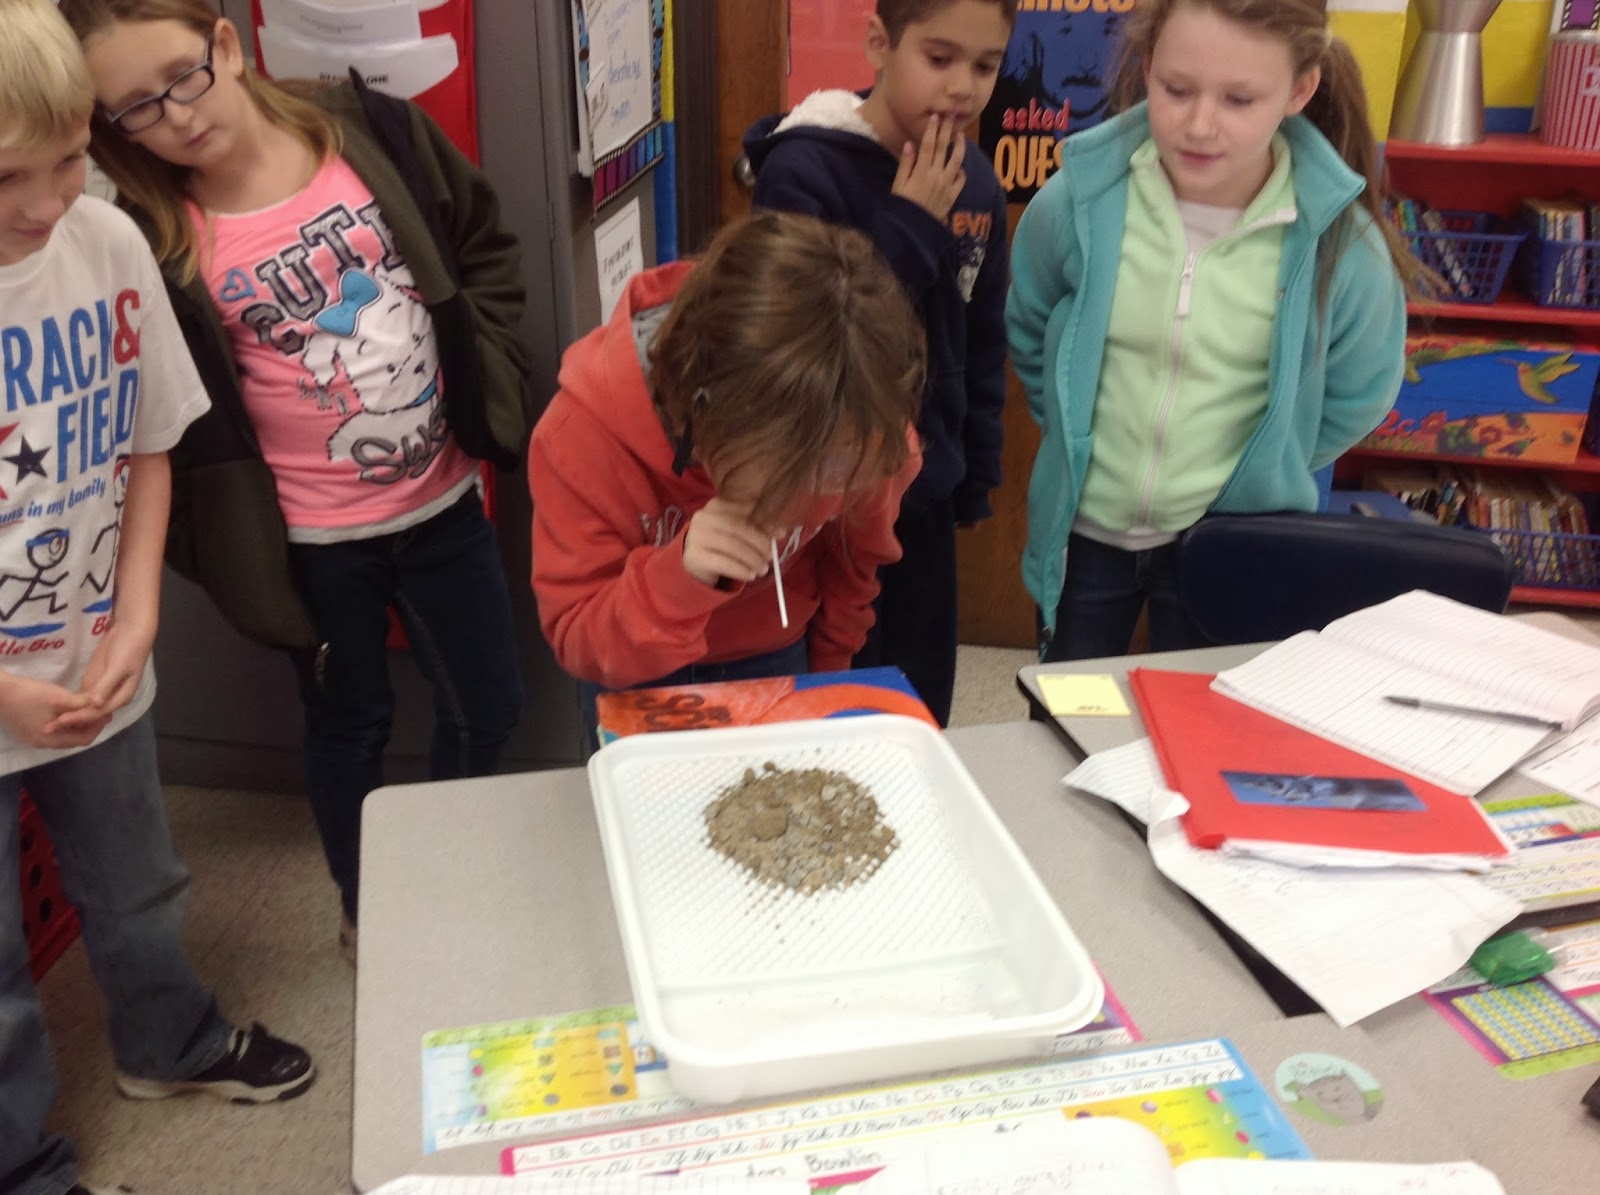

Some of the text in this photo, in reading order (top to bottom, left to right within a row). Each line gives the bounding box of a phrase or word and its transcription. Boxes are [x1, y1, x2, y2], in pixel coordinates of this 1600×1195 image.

[1002, 98, 1071, 131] asked
[27, 501, 43, 517] in
[46, 498, 66, 516] my
[28, 638, 65, 653] Bro
